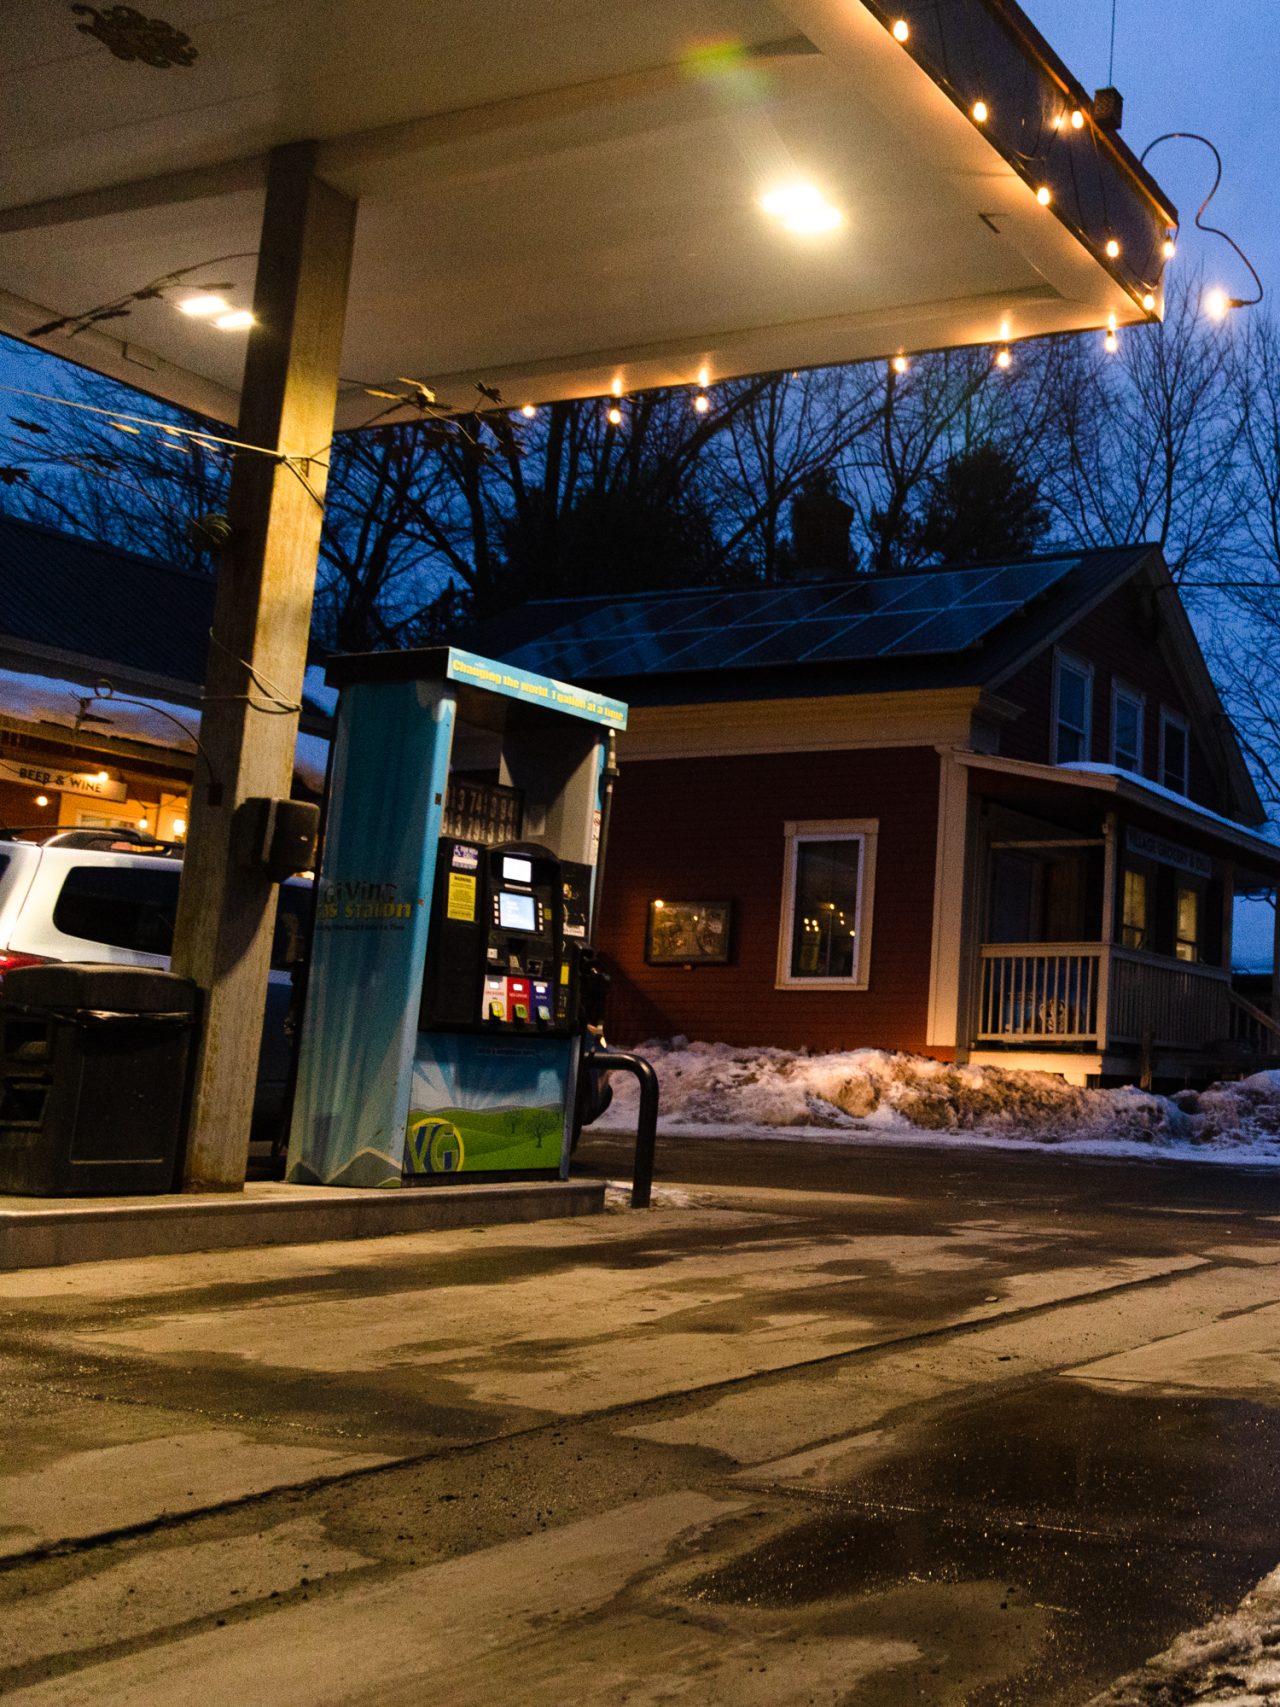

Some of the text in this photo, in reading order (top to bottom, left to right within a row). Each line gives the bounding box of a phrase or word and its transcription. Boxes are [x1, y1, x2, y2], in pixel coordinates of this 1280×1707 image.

[452, 660, 501, 684] Changing
[503, 675, 519, 688] the
[557, 693, 586, 709] gallon
[587, 701, 596, 712] at
[604, 706, 624, 721] time
[19, 768, 102, 793] BEER & WINE
